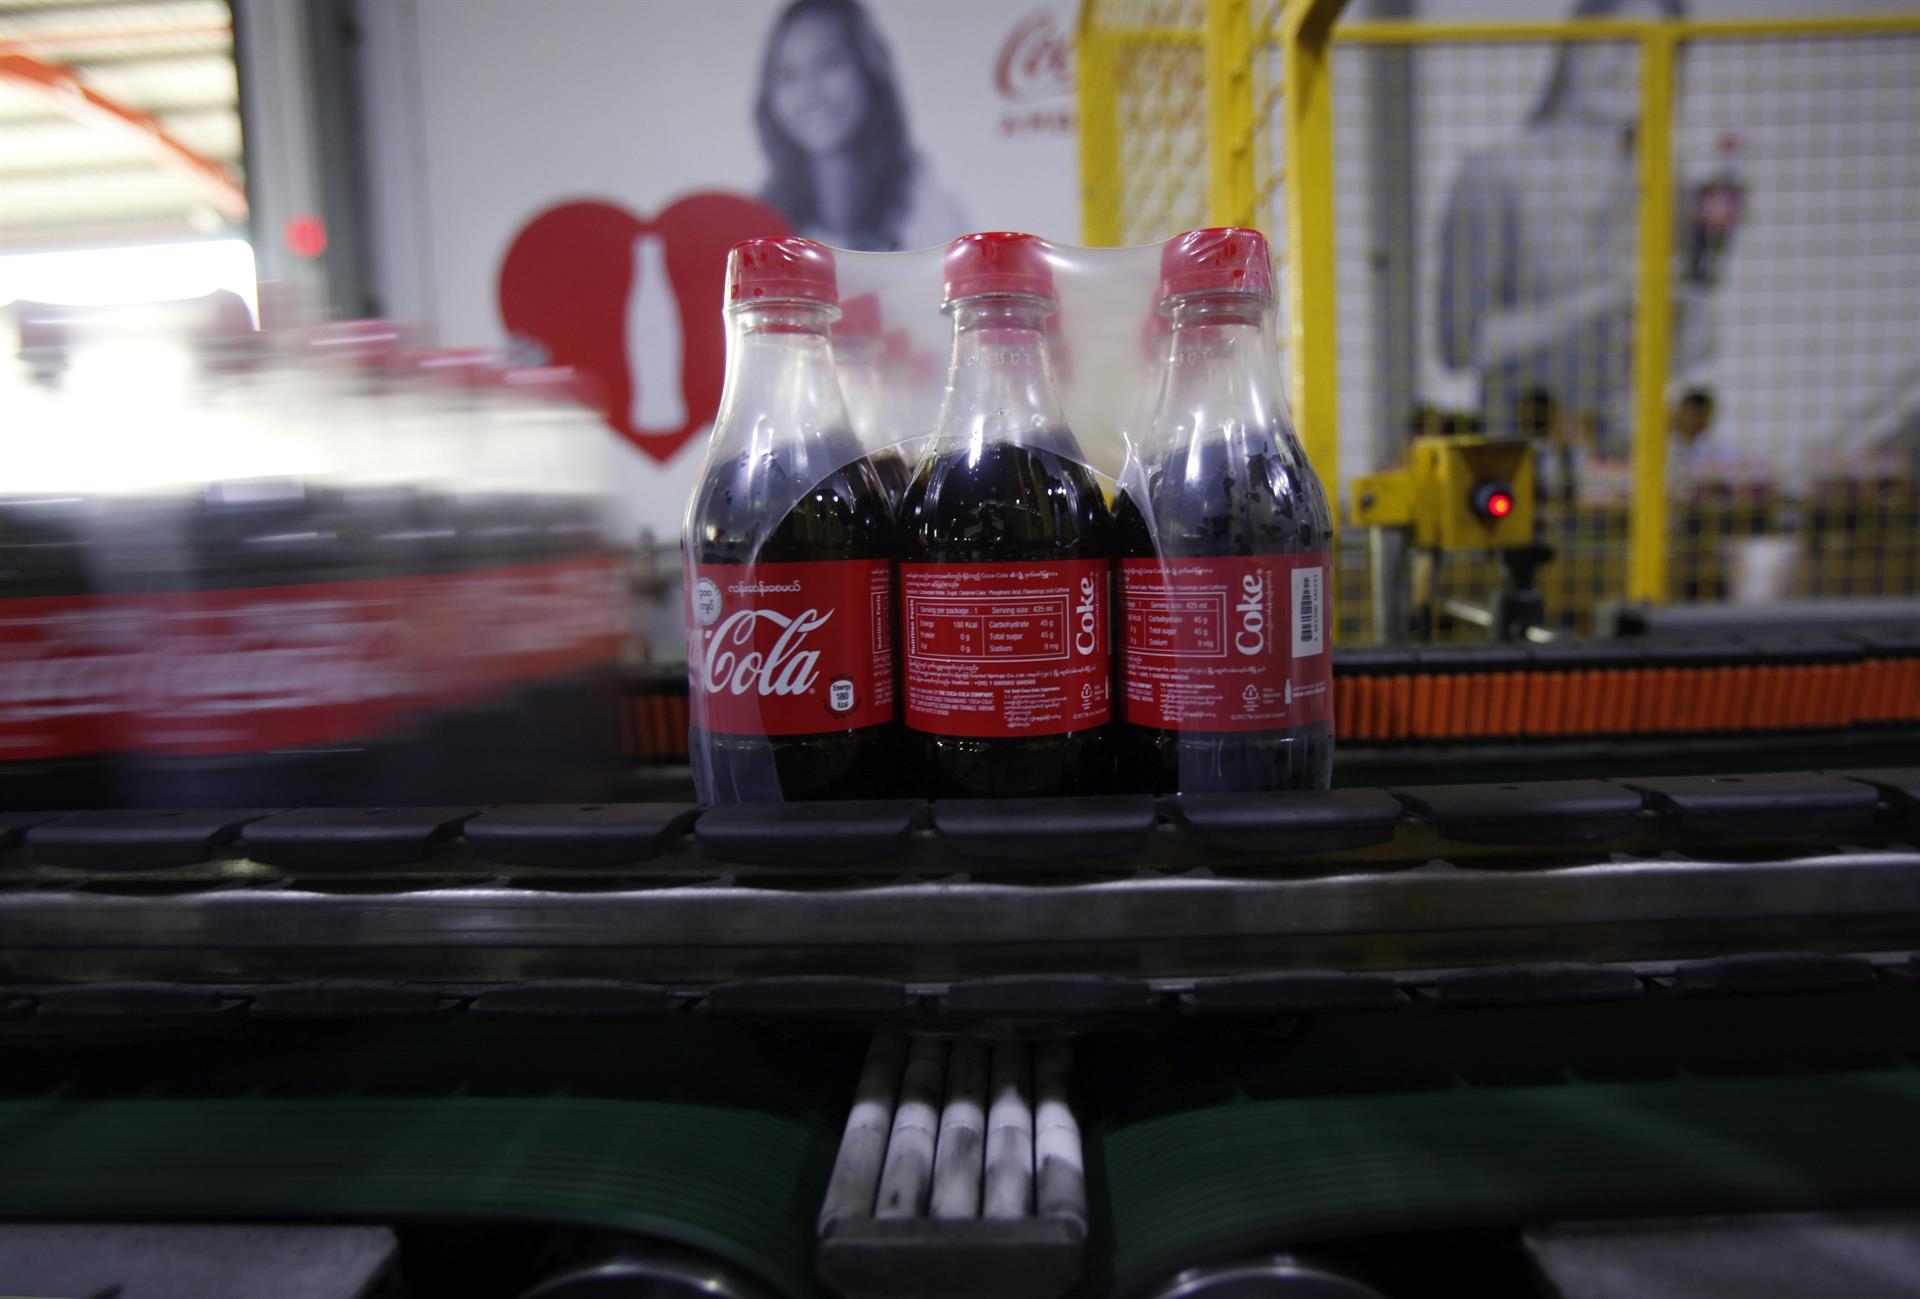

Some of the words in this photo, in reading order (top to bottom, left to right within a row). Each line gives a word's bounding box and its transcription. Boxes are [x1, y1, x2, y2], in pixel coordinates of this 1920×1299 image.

[992, 606, 1015, 615] Serving
[1235, 574, 1264, 656] Coke
[1076, 576, 1095, 656] Coke
[989, 621, 1030, 630] Carbohydrate
[1040, 620, 1049, 628] 45
[990, 632, 1005, 641] Total
[1005, 633, 1024, 642] sugar
[1040, 631, 1049, 639] 45
[990, 645, 1014, 653] Sodium
[832, 684, 852, 692] Energy
[836, 692, 849, 701] 180
